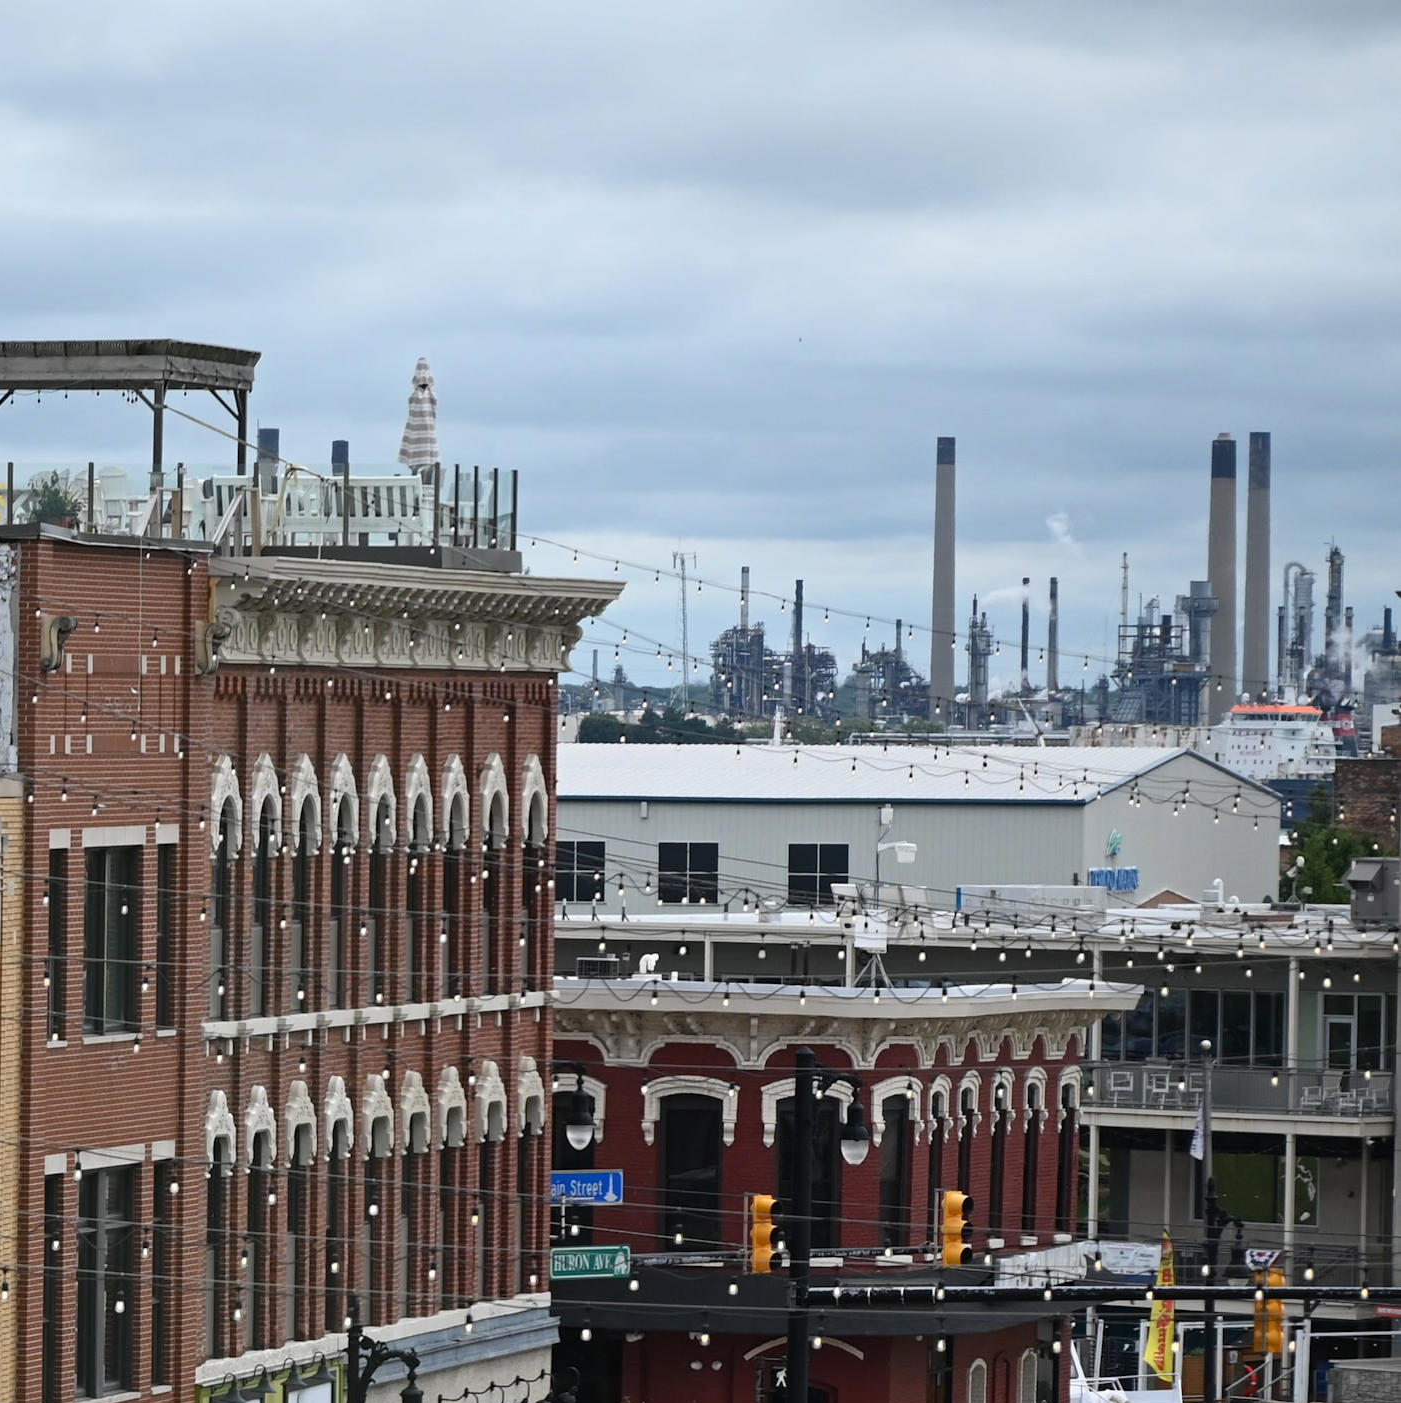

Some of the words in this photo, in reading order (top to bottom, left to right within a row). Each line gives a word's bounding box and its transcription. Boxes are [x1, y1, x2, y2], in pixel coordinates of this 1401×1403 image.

[550, 1180, 565, 1197] ain
[570, 1180, 603, 1196] Street
[553, 1254, 590, 1272] HURON
